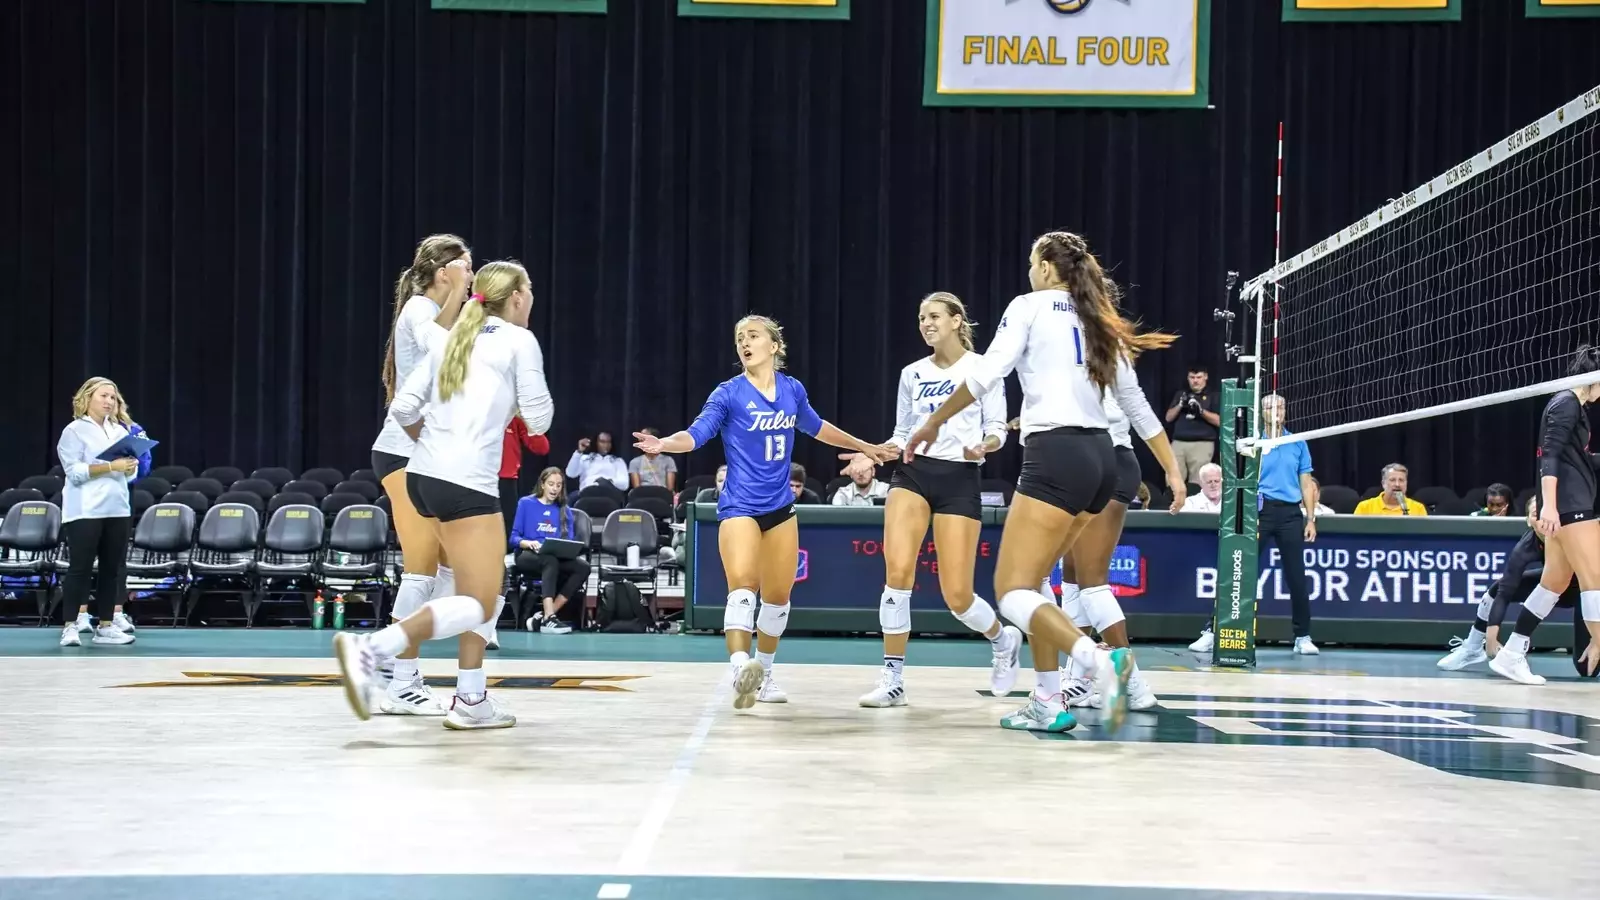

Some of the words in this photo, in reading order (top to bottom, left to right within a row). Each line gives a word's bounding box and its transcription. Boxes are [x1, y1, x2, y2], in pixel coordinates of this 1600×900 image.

[963, 35, 1067, 65] FINAL
[1076, 36, 1170, 66] FOUR
[765, 434, 787, 462] 13
[1232, 549, 1243, 580] sports
[1269, 547, 1350, 568] POUD
[1355, 549, 1469, 571] SPONSOR
[1474, 551, 1507, 571] OF
[1219, 638, 1247, 650] BEARS
